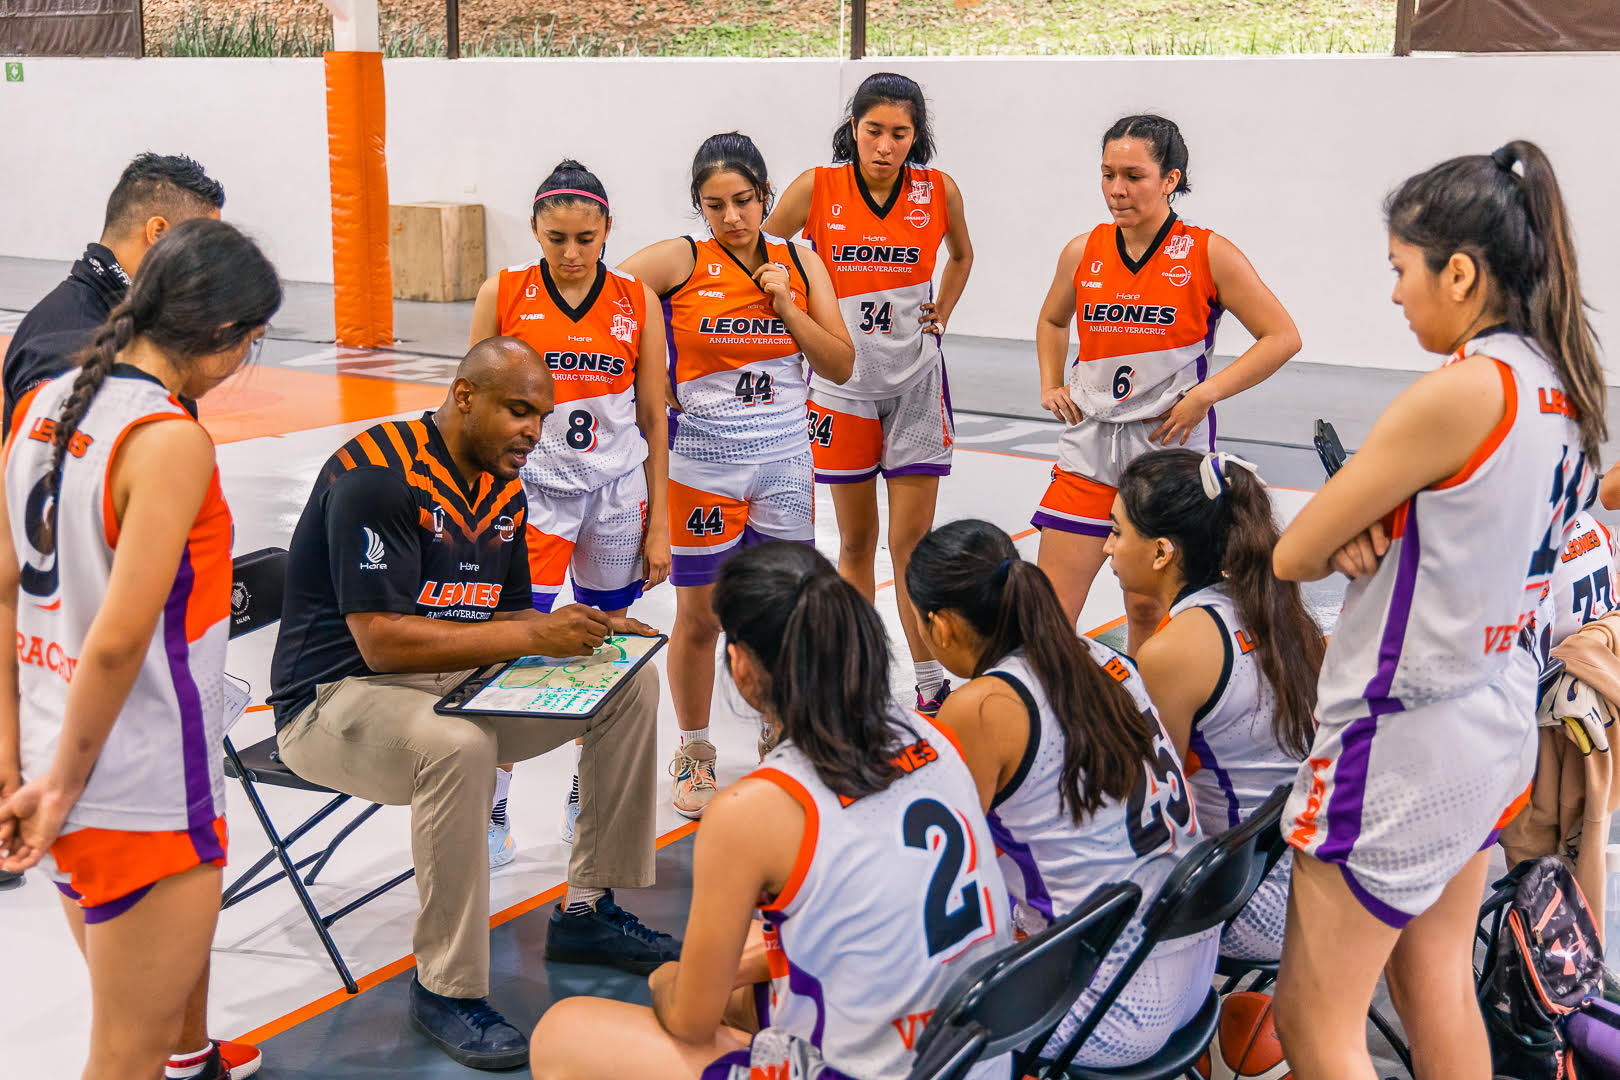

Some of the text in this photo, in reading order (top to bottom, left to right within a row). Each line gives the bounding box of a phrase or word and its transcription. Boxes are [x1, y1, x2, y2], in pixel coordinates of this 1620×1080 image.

[862, 234, 887, 242] Hare
[832, 245, 920, 265] LEONES
[836, 264, 913, 273] ANÁHUAC VERACRUZ
[1115, 292, 1141, 300] Hare
[859, 301, 894, 335] 34
[1082, 303, 1178, 325] LEONES
[699, 316, 792, 336] LEONE
[1089, 325, 1166, 335] ANÁHUAC VERACRUZ
[709, 336, 793, 346] ANÁHUAC VERACRUZ
[544, 351, 626, 376] EONES
[552, 372, 579, 381] ÁHUAC
[1112, 365, 1136, 402] 6
[735, 371, 774, 407] 44
[565, 408, 598, 452] 8
[807, 411, 834, 447] 34
[686, 506, 724, 537] 44
[1560, 529, 1601, 564] LEONES
[360, 562, 388, 570] Hare
[460, 562, 480, 571] Hare
[1572, 565, 1617, 626] 77
[903, 798, 995, 965] 2
[1554, 1050, 1564, 1080] UND
